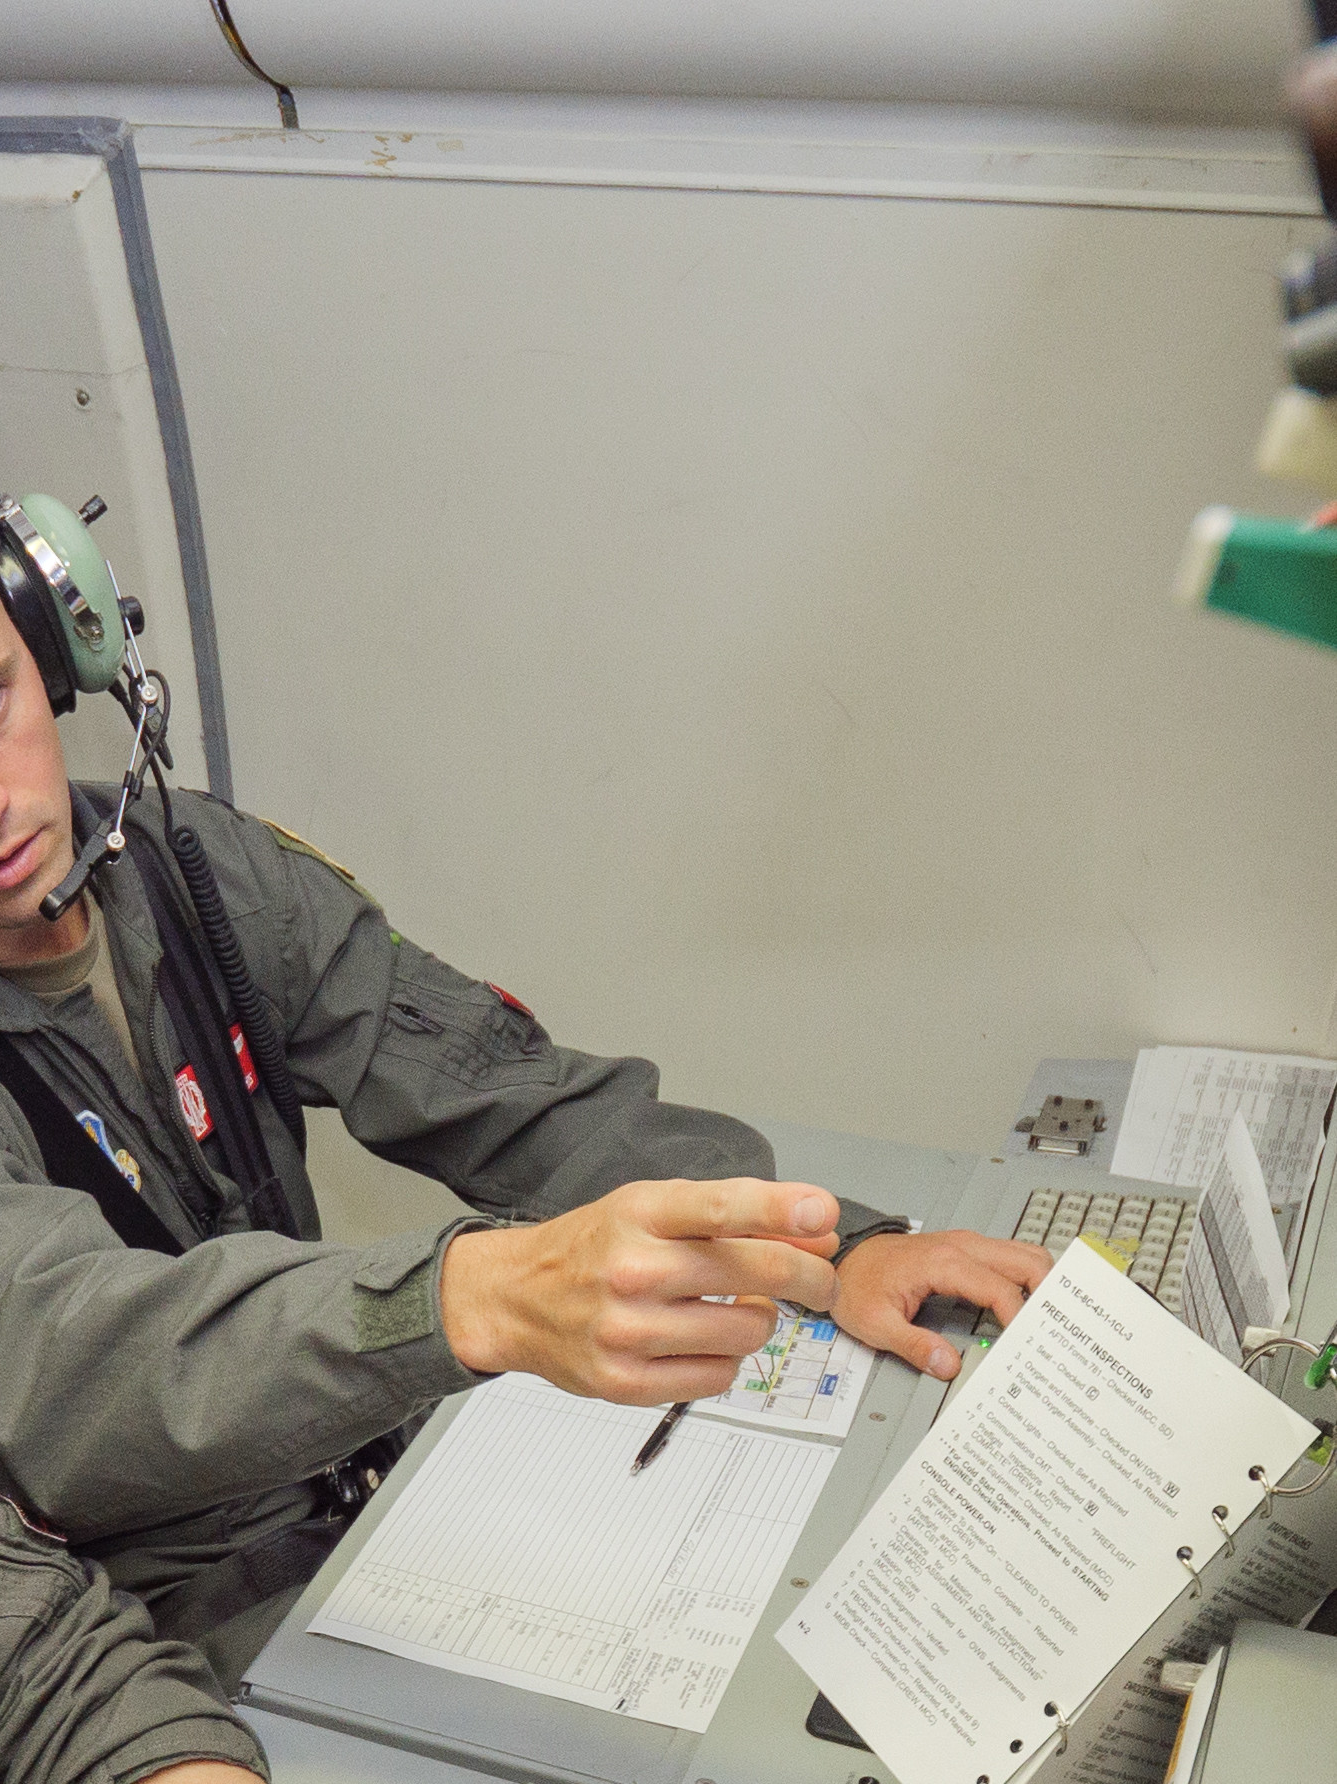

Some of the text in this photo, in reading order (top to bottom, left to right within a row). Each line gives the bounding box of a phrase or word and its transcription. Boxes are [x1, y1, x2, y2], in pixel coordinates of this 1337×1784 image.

[1035, 1343, 1087, 1391] Seat Checked
[1038, 1299, 1155, 1400] PREFLIGHT INSPECTIONS
[1046, 1327, 1070, 1350] AFTO
[1105, 1377, 1138, 1408] Checked
[1013, 1371, 1043, 1400] Portable
[1039, 1394, 1067, 1421] Oxygen
[1063, 1415, 1098, 1448] Assembly
[1022, 1359, 1165, 1486] Oxygen Interphone Checked ON/100%
[919, 1459, 996, 1535] CONSOLE POWER-ON
[942, 1455, 1003, 1514] ENGINES Checklist
[975, 1421, 1004, 1450] Preflight
[1007, 1450, 1044, 1487] Inspections
[1047, 1488, 1073, 1513] Report
[984, 1410, 1037, 1460] Communications
[1054, 1474, 1086, 1505] Checked
[996, 1395, 1024, 1423] Console
[1021, 1417, 1043, 1440] Lights
[1095, 1485, 1130, 1518] Required
[1031, 1488, 1054, 1511] MCC)
[937, 1543, 958, 1566] MCC)
[950, 1523, 976, 1550] CREW)
[960, 1460, 978, 1479] Cold
[977, 1476, 996, 1496] Start
[994, 1492, 1034, 1532] Operations,
[1032, 1528, 1062, 1559] Proceed
[1070, 1565, 1109, 1603] STARTING
[961, 1441, 988, 1468] Survival
[984, 1463, 1020, 1498] Equipment
[1059, 1534, 1092, 1566] Required
[1088, 1561, 1115, 1588] (MCC)
[891, 1576, 916, 1602] CREW)
[899, 1523, 1037, 1665] Clearance Mission Crew Assignment
[903, 1555, 923, 1577] MCC)
[912, 1504, 1064, 1658] Preflight and/or Power-On Complete Reported
[924, 1562, 968, 1608] ASSIGNMENT
[980, 1620, 1010, 1651] SWITCH
[926, 1486, 959, 1519] Clearance
[965, 1524, 998, 1558] Power-On
[1047, 1605, 1080, 1638] POWER-
[857, 1578, 936, 1663] Console Checkout Initiated
[865, 1567, 949, 1658] Console Assignment Verified
[879, 1549, 1027, 1703] Mission Crew Cleared Assignments
[882, 1624, 911, 1657] Checkout
[913, 1657, 938, 1686] Initiated
[840, 1599, 977, 1748] Preflight and/or Power-On Reported, Required
[847, 1626, 867, 1649] Check
[869, 1650, 898, 1682] Complete
[917, 1703, 938, 1726] MCC)
